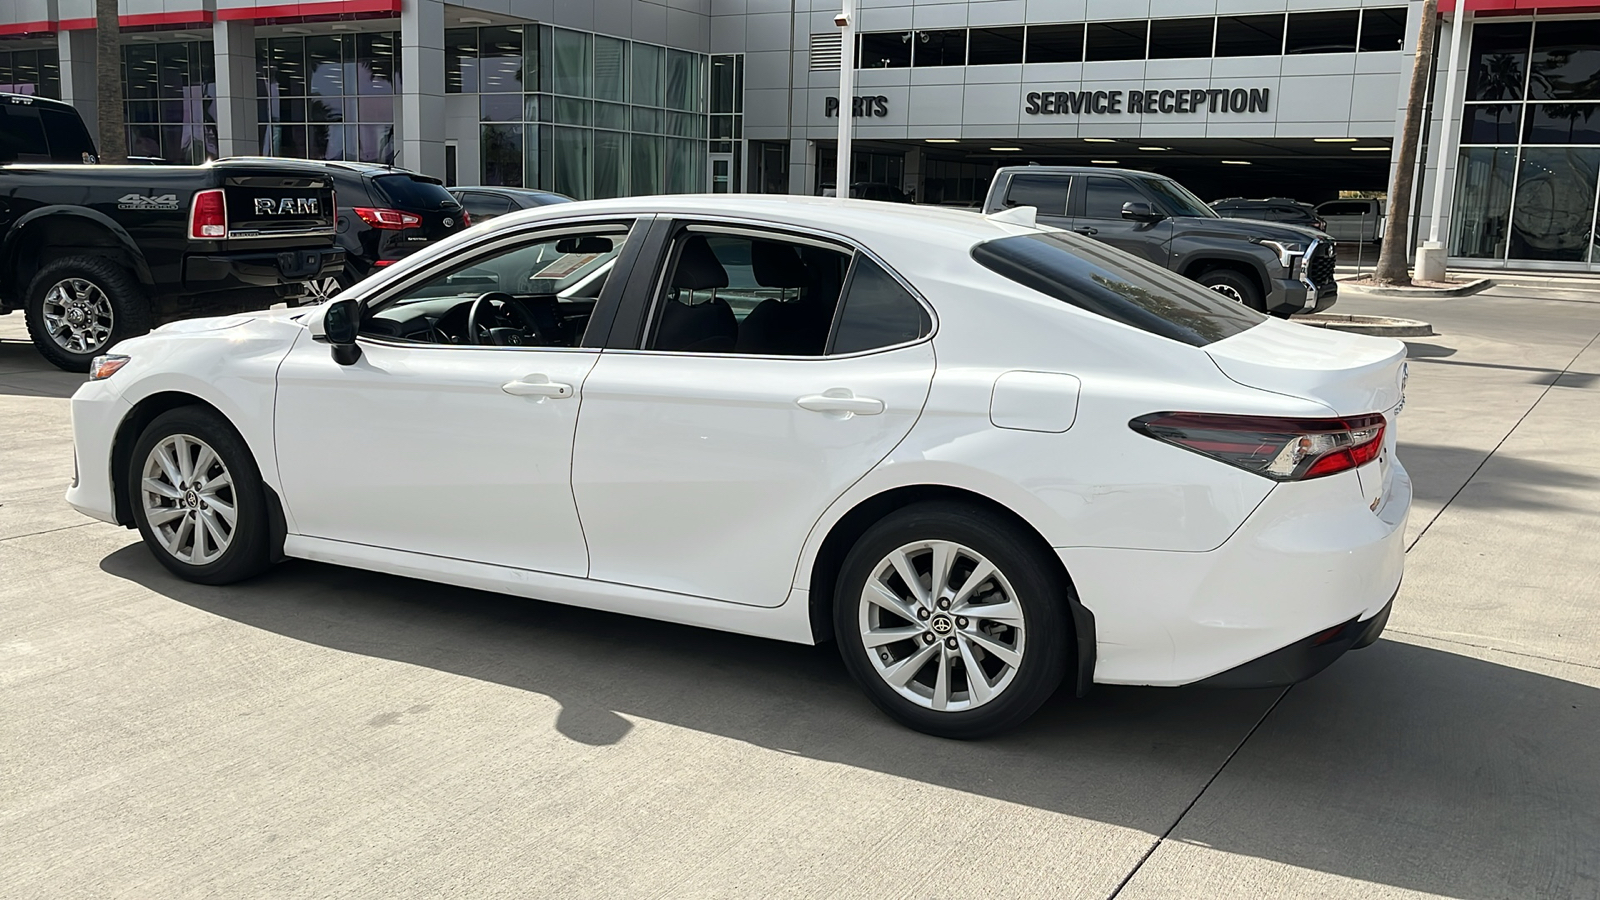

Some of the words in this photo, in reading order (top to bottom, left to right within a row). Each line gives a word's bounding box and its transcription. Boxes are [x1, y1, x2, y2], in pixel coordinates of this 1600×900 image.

[825, 95, 888, 118] PRTS
[1025, 90, 1122, 115] SERVICE
[1127, 88, 1270, 114] RECEPTION
[253, 197, 319, 216] RAM
